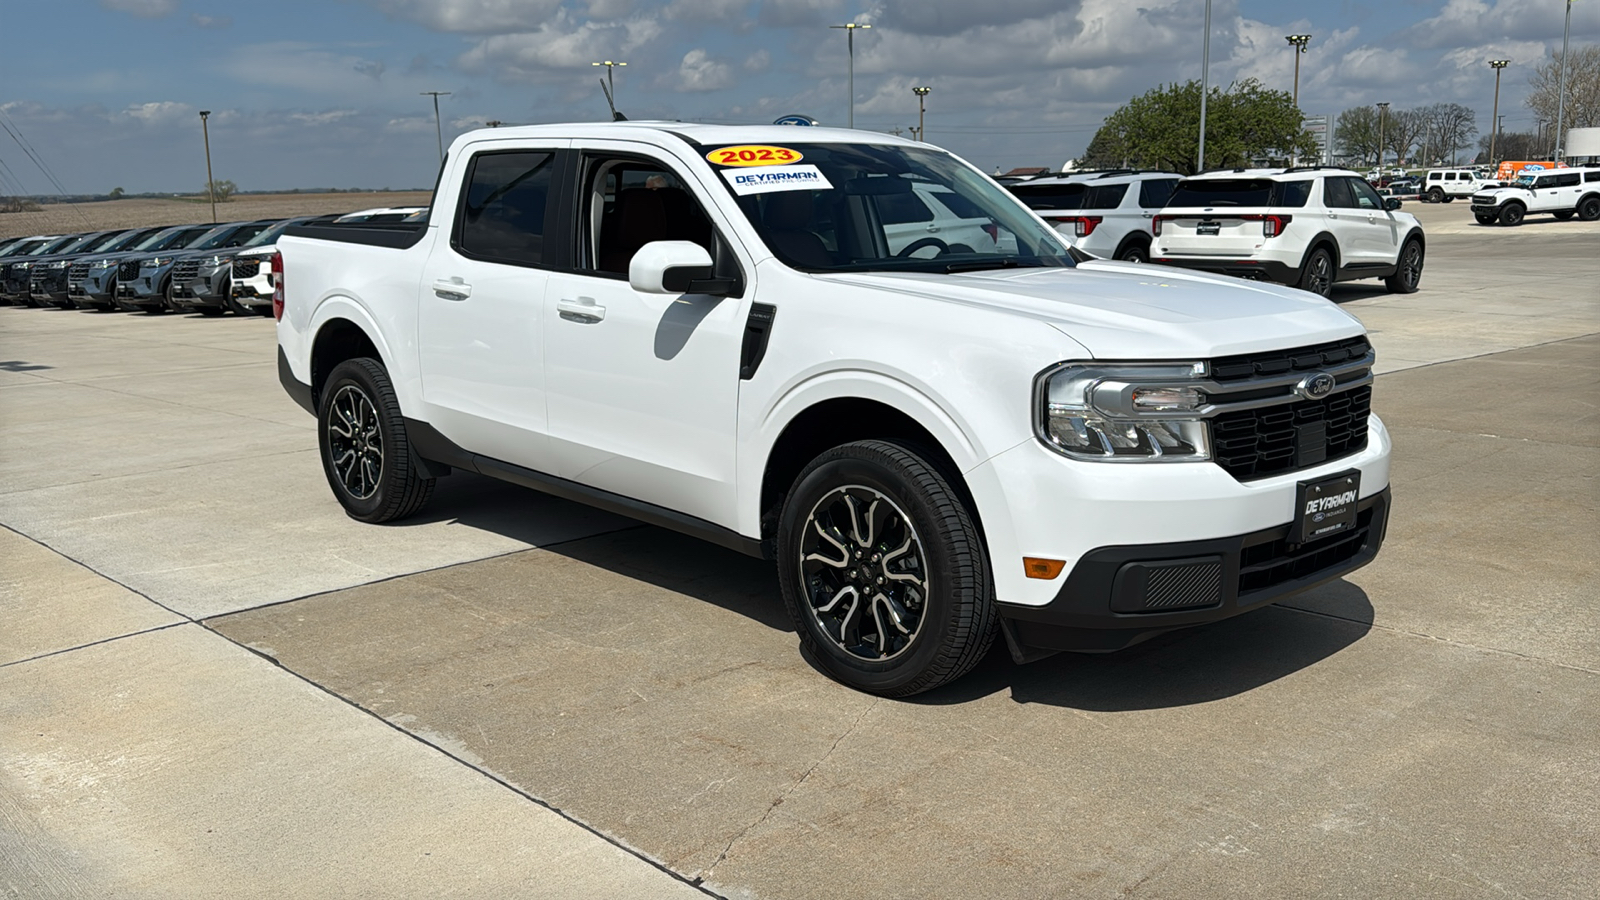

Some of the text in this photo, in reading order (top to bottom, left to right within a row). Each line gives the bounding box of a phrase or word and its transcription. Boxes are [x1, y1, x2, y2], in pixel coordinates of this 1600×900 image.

[719, 149, 795, 163] 2023
[735, 171, 818, 184] DEYARMAN
[1313, 378, 1331, 394] Ford
[1305, 489, 1357, 515] DEYARMAN
